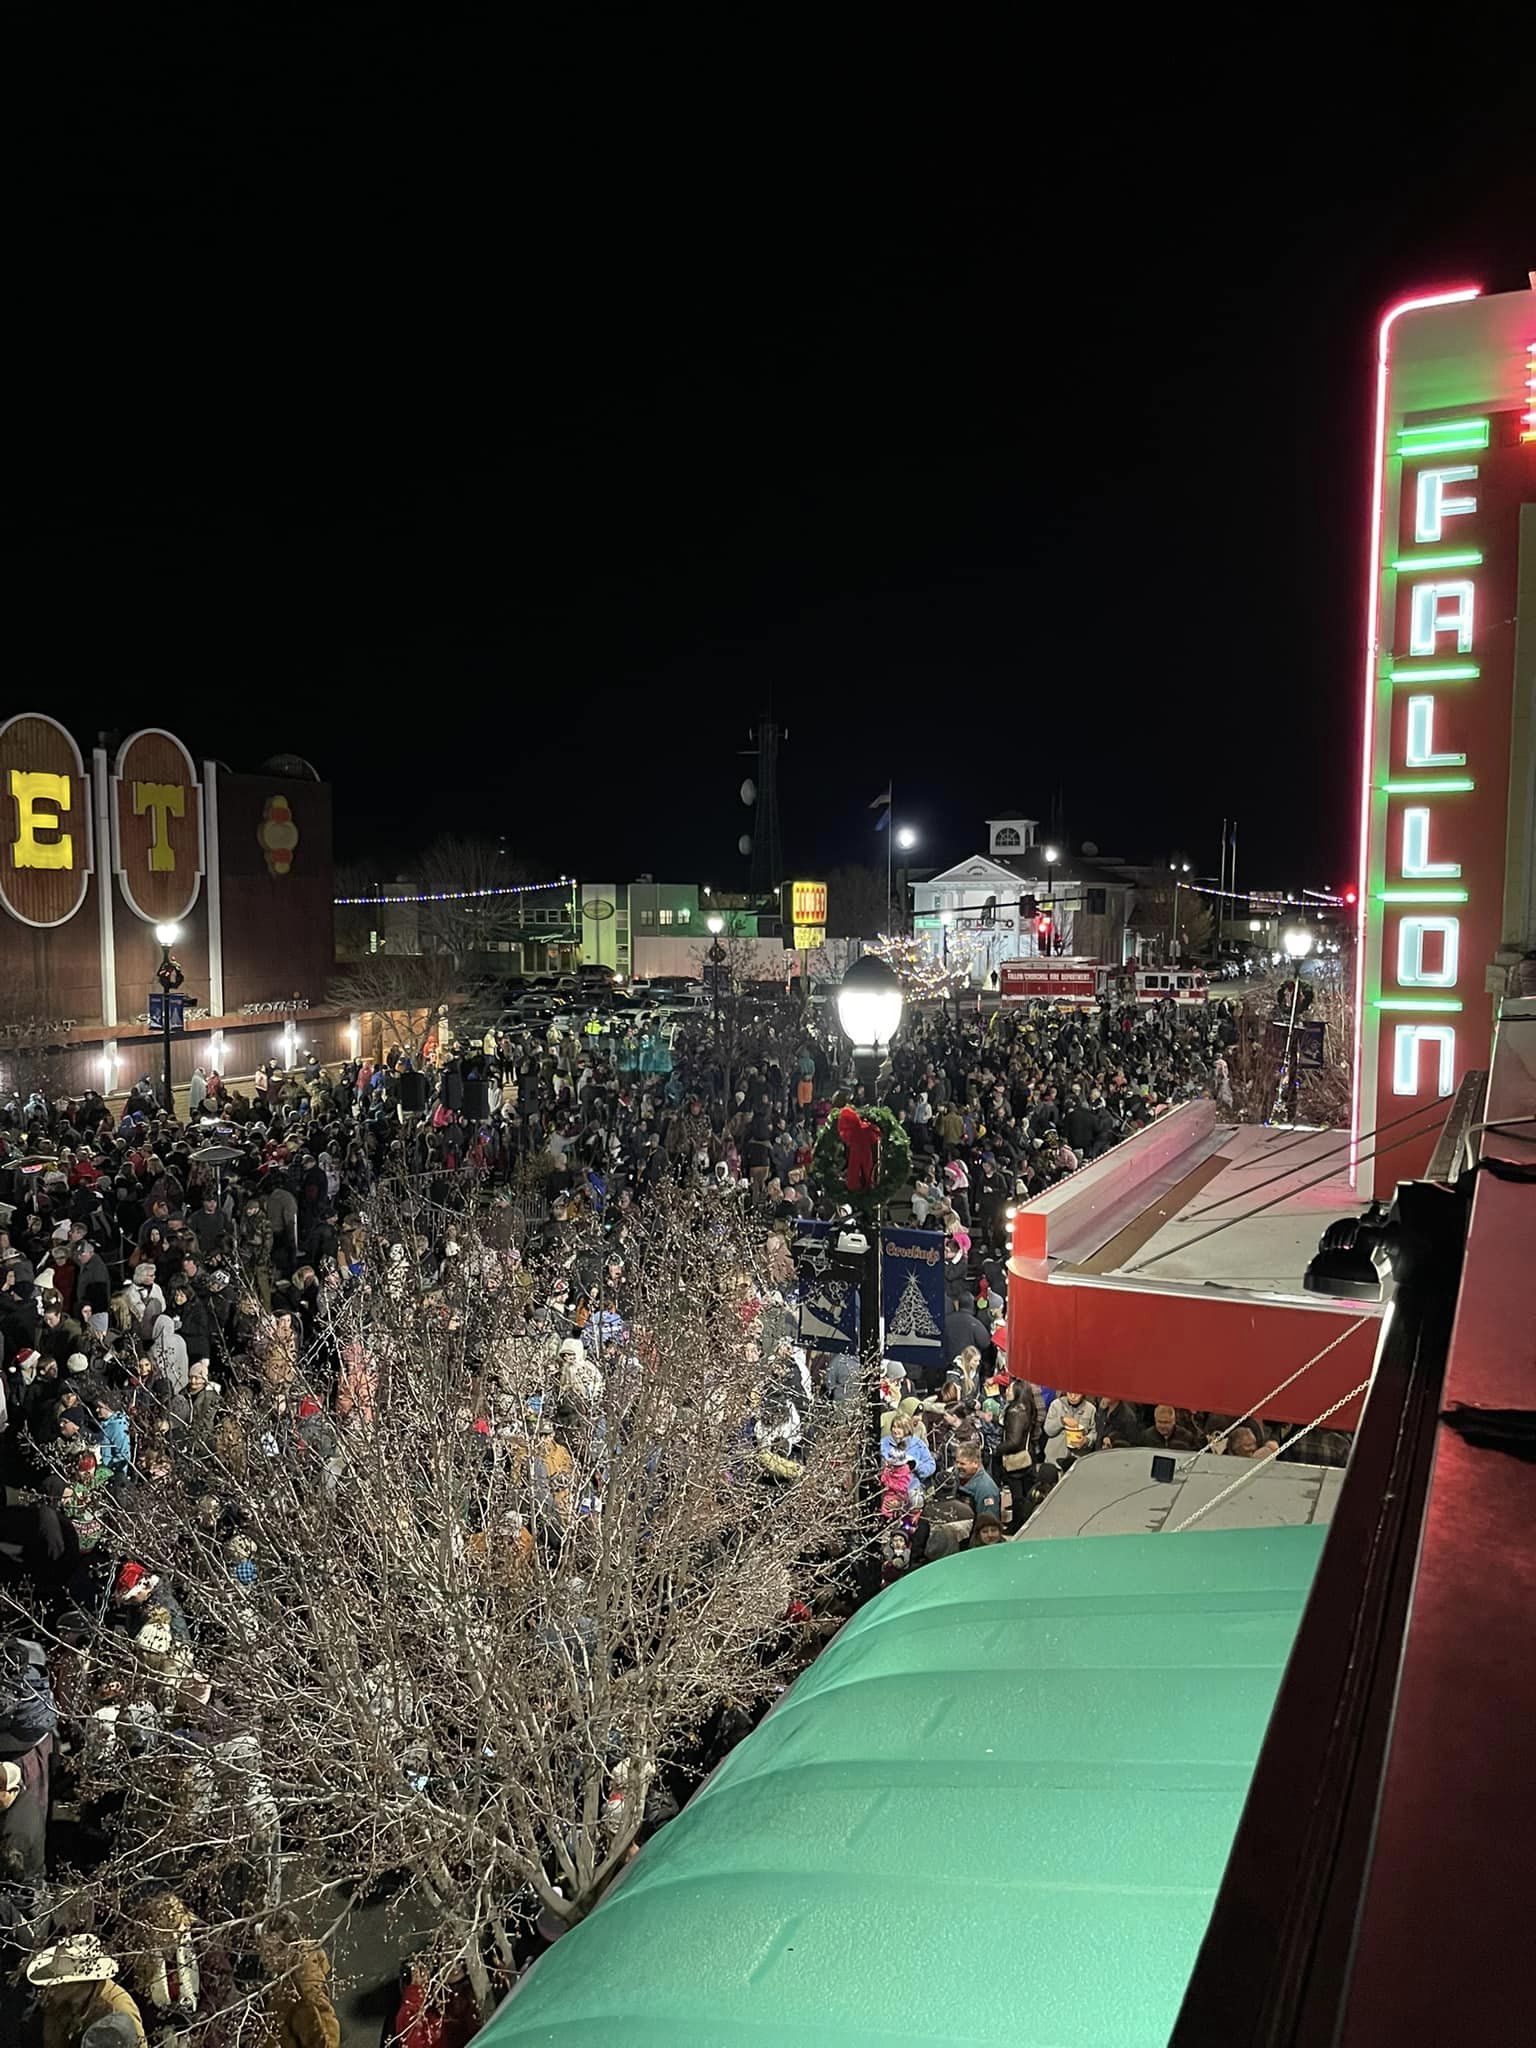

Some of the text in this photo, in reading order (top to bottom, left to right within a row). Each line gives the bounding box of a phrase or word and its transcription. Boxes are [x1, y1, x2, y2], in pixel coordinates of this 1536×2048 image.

[1393, 465, 1478, 1097] FALLON
[243, 1000, 310, 1016] HOUSE
[886, 1241, 940, 1266] Greetings
